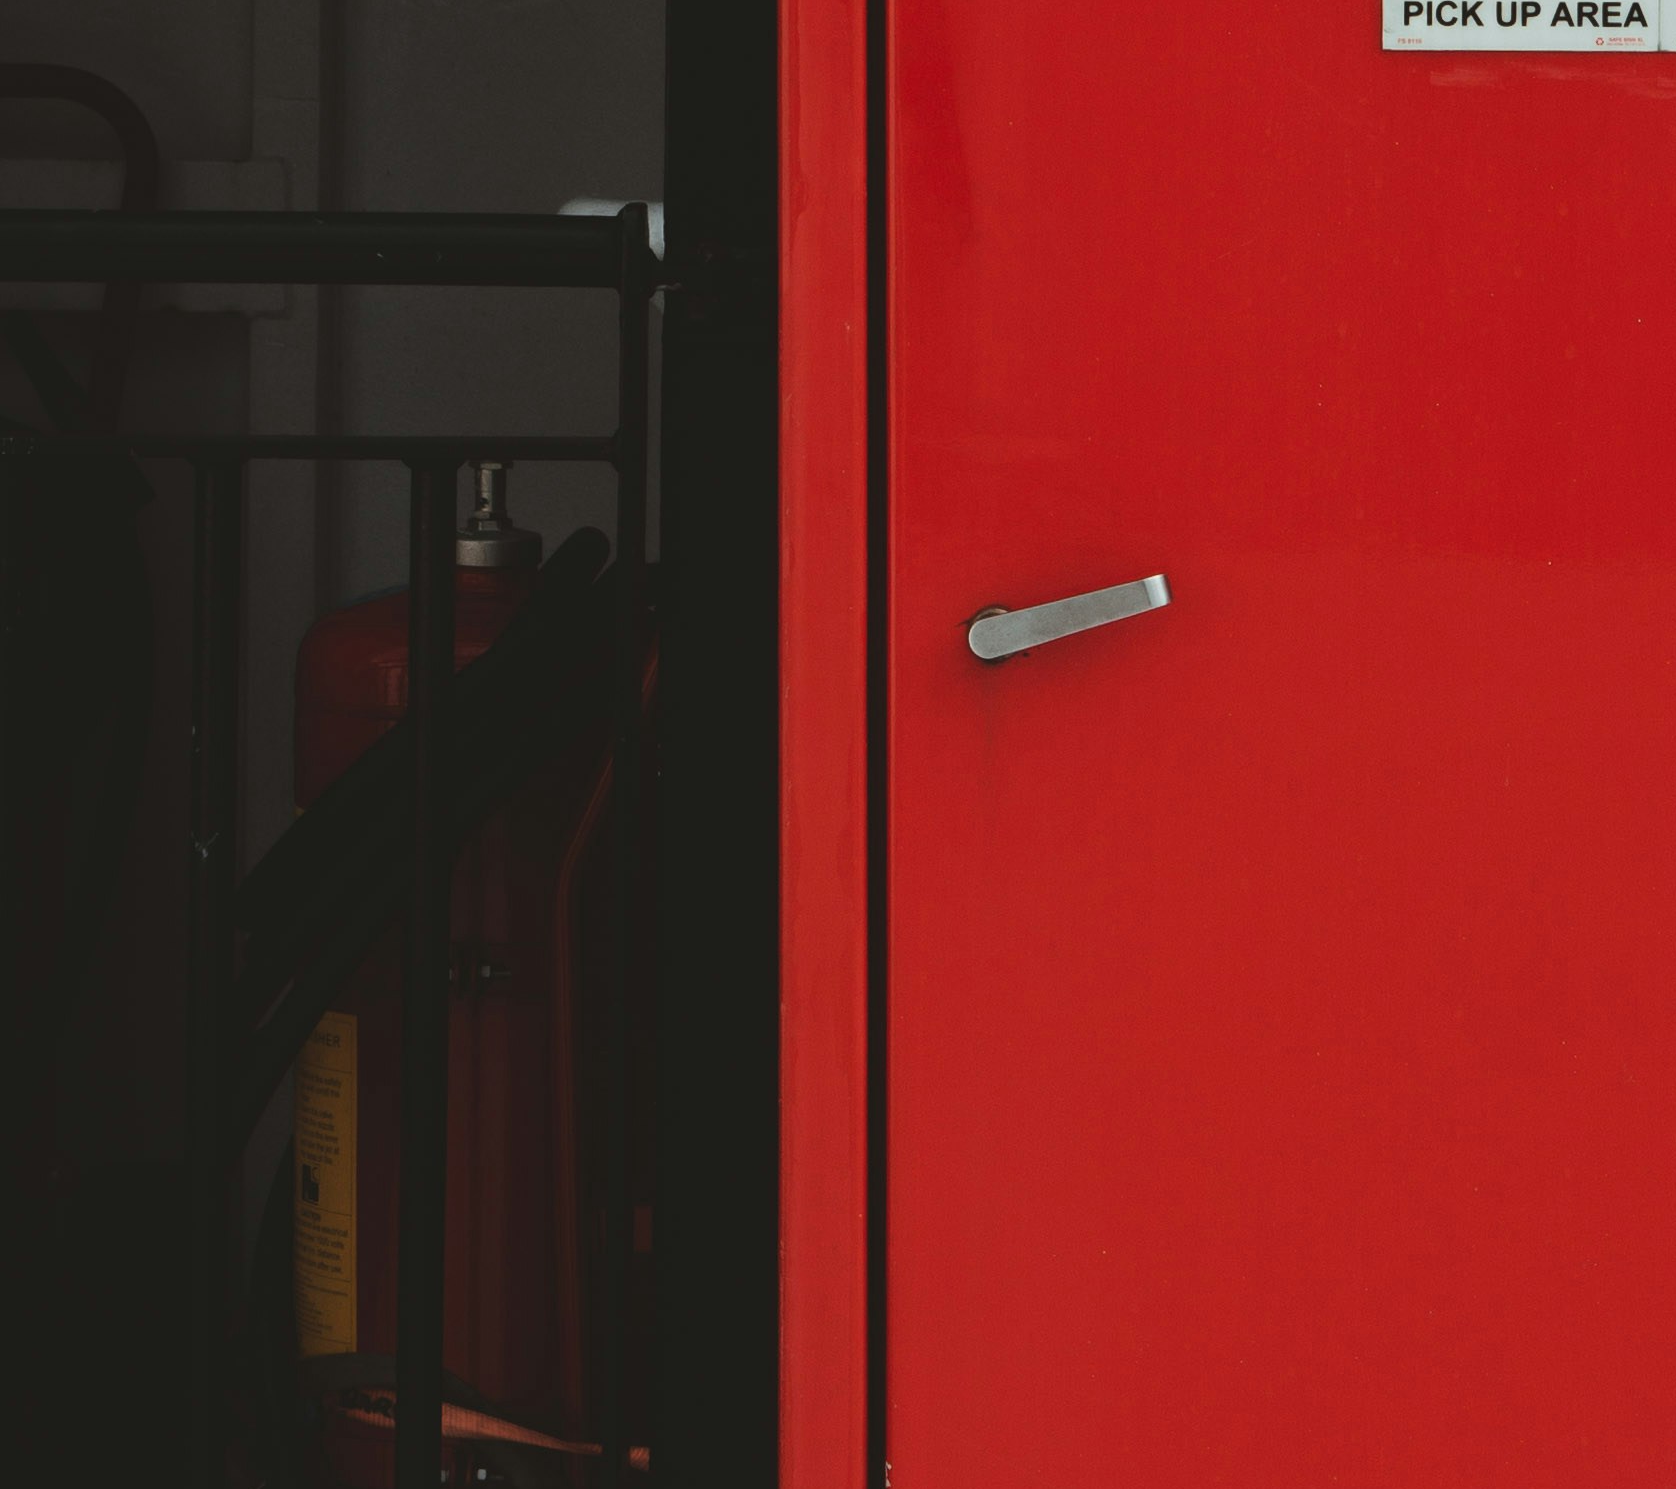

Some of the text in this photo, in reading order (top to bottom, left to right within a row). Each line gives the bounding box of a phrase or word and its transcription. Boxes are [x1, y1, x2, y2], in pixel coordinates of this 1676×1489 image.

[1403, 0, 1648, 28] PICK UP AREA
